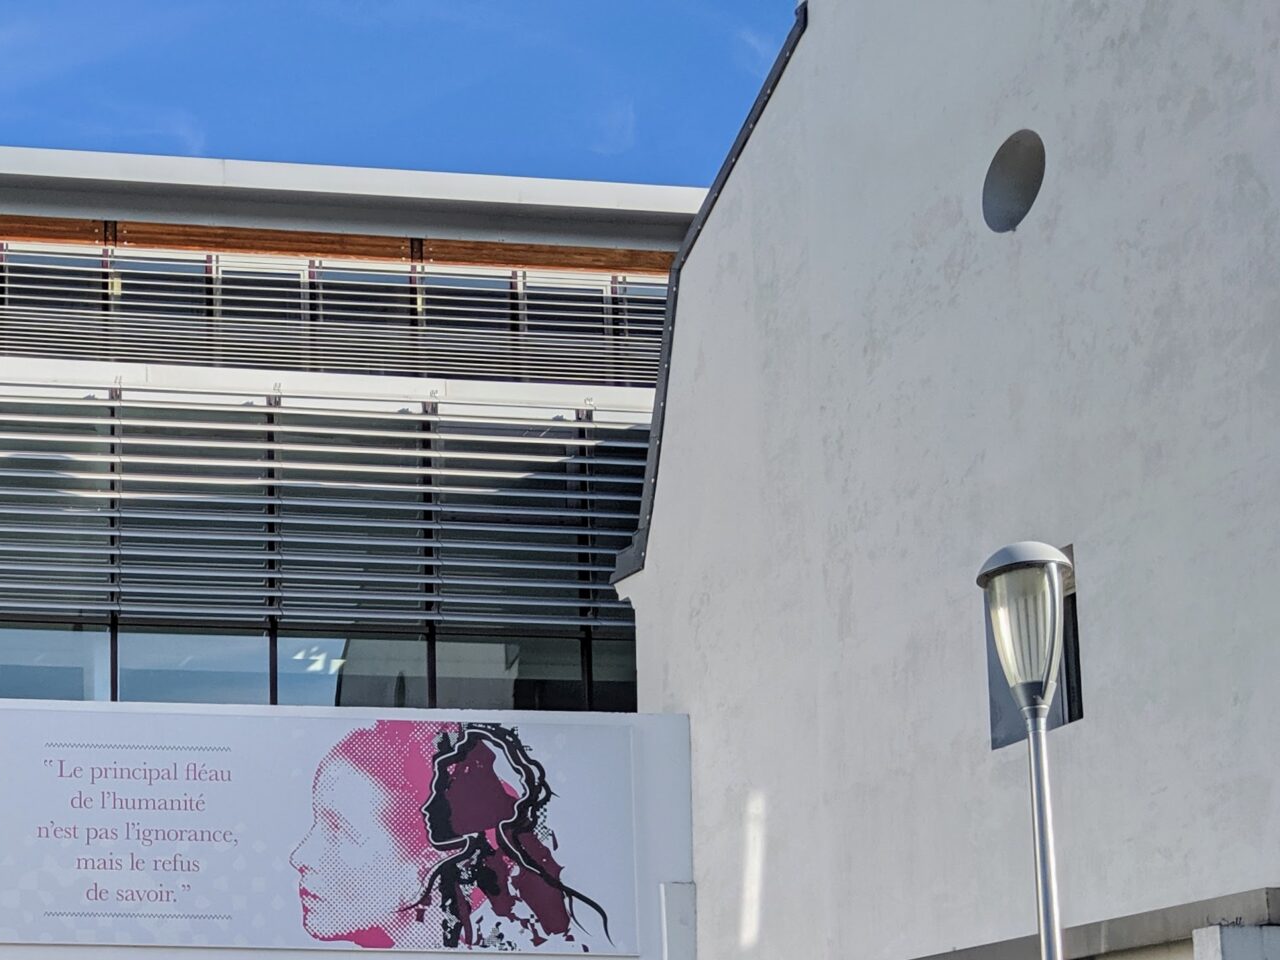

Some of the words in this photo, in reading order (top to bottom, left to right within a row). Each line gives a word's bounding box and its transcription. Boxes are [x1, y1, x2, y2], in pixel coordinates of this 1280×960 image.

[90, 761, 178, 786] principal
[184, 762, 232, 782] fléau
[70, 790, 94, 809] de
[85, 826, 119, 846] pas
[75, 852, 123, 871] mais
[130, 853, 146, 872] le
[152, 853, 201, 873] refus
[86, 882, 109, 901] de
